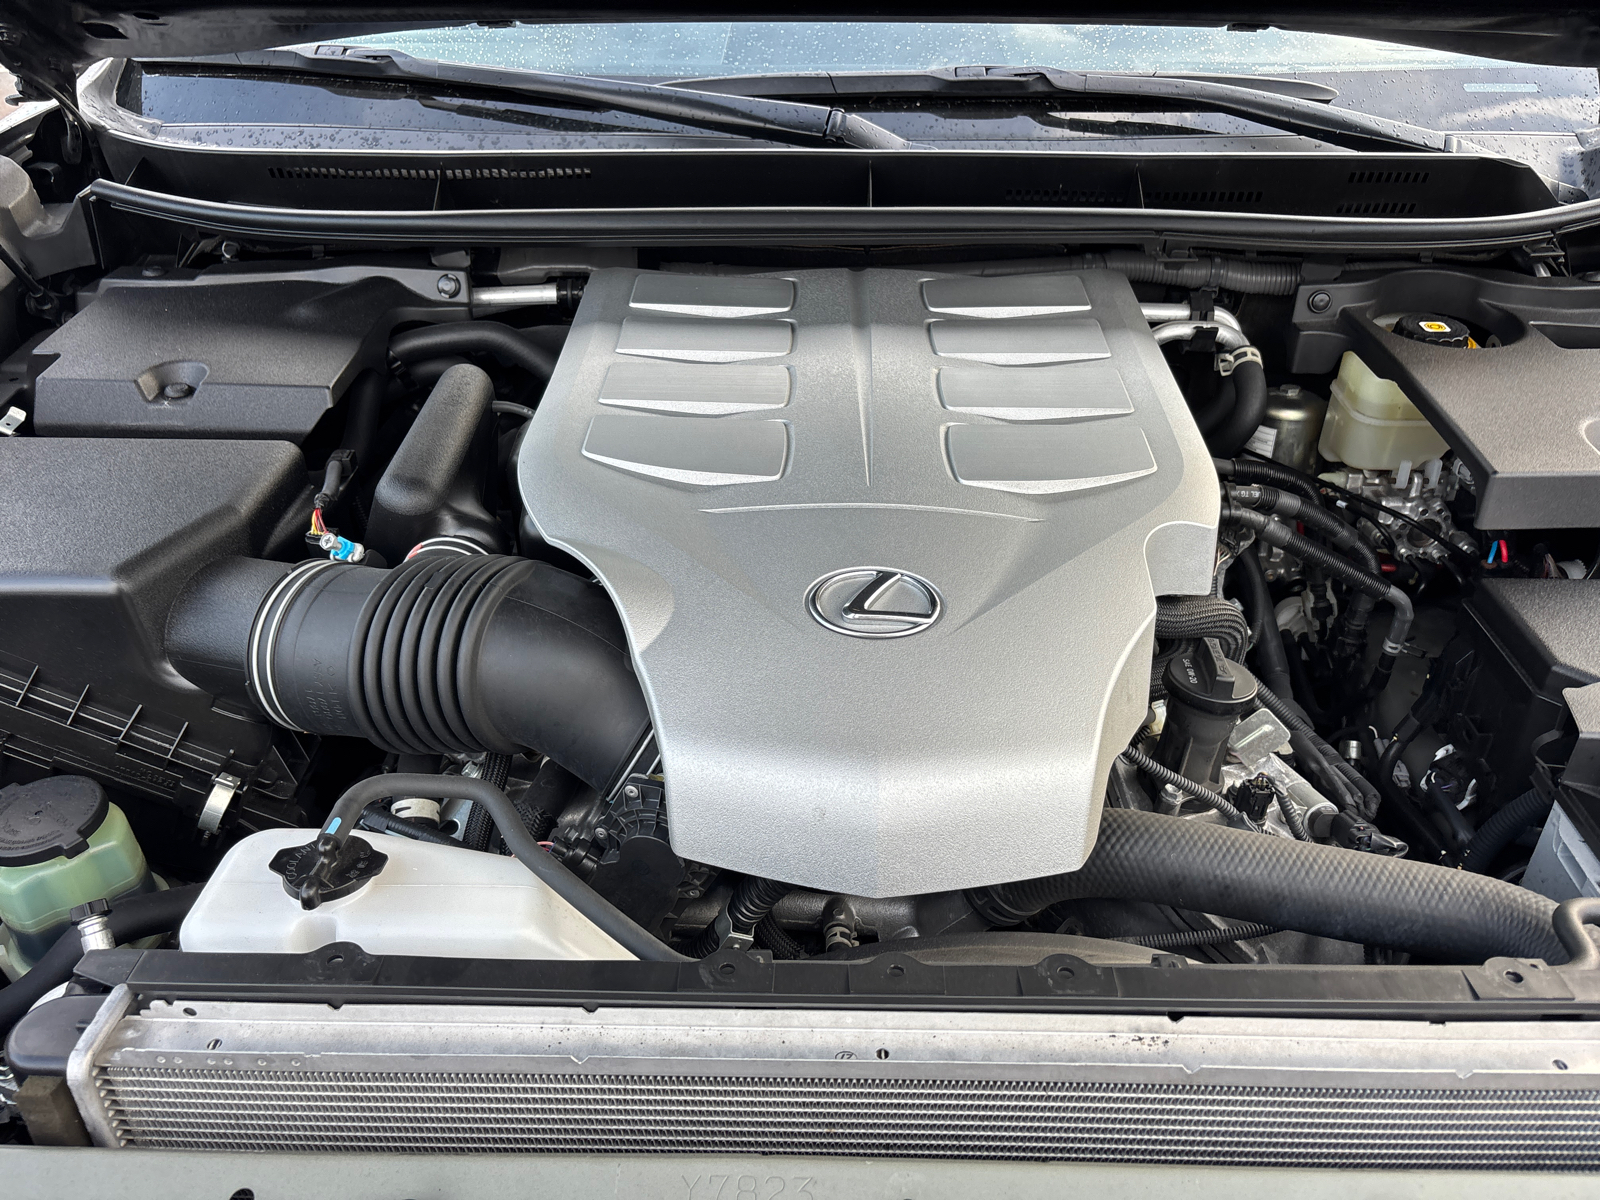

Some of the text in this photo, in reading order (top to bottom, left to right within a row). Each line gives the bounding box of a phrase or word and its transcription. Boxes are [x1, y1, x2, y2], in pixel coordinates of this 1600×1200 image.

[1182, 658, 1198, 685] SAE 0W-20
[681, 1174, 815, 1200] Y7823
